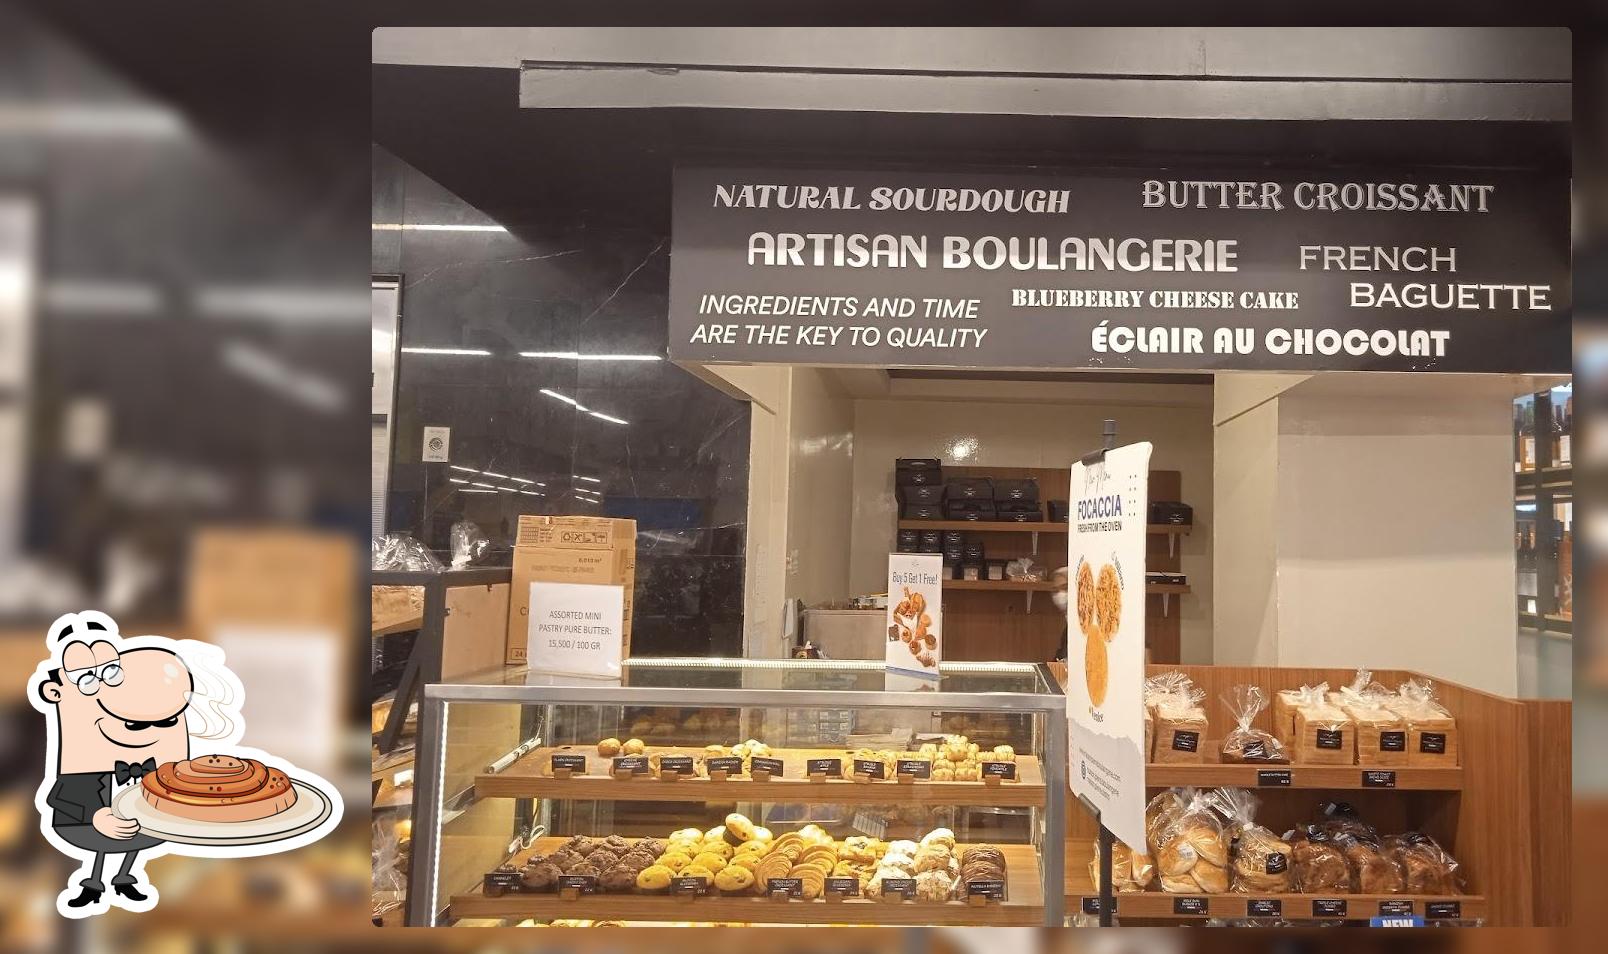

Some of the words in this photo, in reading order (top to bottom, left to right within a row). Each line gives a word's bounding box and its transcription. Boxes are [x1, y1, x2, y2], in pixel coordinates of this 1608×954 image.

[714, 185, 860, 209] NATURAL
[869, 187, 1070, 213] SOURDOUGH
[1142, 181, 1284, 211] BUTTER
[1294, 182, 1494, 212] CROISSANT
[748, 232, 926, 268] ARTISAN
[943, 236, 1238, 272] BOULANGERIE
[1300, 246, 1456, 271] FRENCH
[700, 295, 858, 316] INGREDIENTS
[863, 298, 915, 317] AND
[923, 299, 980, 318] TIME
[1012, 289, 1144, 307] BLUEBERRY
[1149, 291, 1234, 308] CHEESE
[1240, 292, 1298, 308] CAKE
[1351, 283, 1551, 310] BAGUETTE
[690, 325, 738, 343] ARE
[745, 325, 791, 344] THE
[796, 326, 844, 345] KEY
[850, 327, 880, 346] TO
[887, 328, 988, 347] QUALITY
[1092, 320, 1203, 353] ÉCLAIR
[1214, 328, 1254, 354] AU
[1265, 328, 1449, 356] CHOCOLAT
[1077, 494, 1122, 520] FOCACCIA
[1099, 522, 1108, 532] THE
[1108, 520, 1122, 532] OVEN
[892, 571, 903, 585] Buy
[904, 572, 908, 584] 5
[908, 572, 918, 584] Get
[923, 573, 938, 585] Free!
[549, 610, 584, 620] ASSORTED
[584, 612, 602, 620] MINI
[539, 624, 563, 633] PASTRY
[564, 625, 582, 634] PURE
[583, 626, 612, 635] BUTTER:
[577, 641, 590, 650] 100
[590, 641, 601, 650] GR
